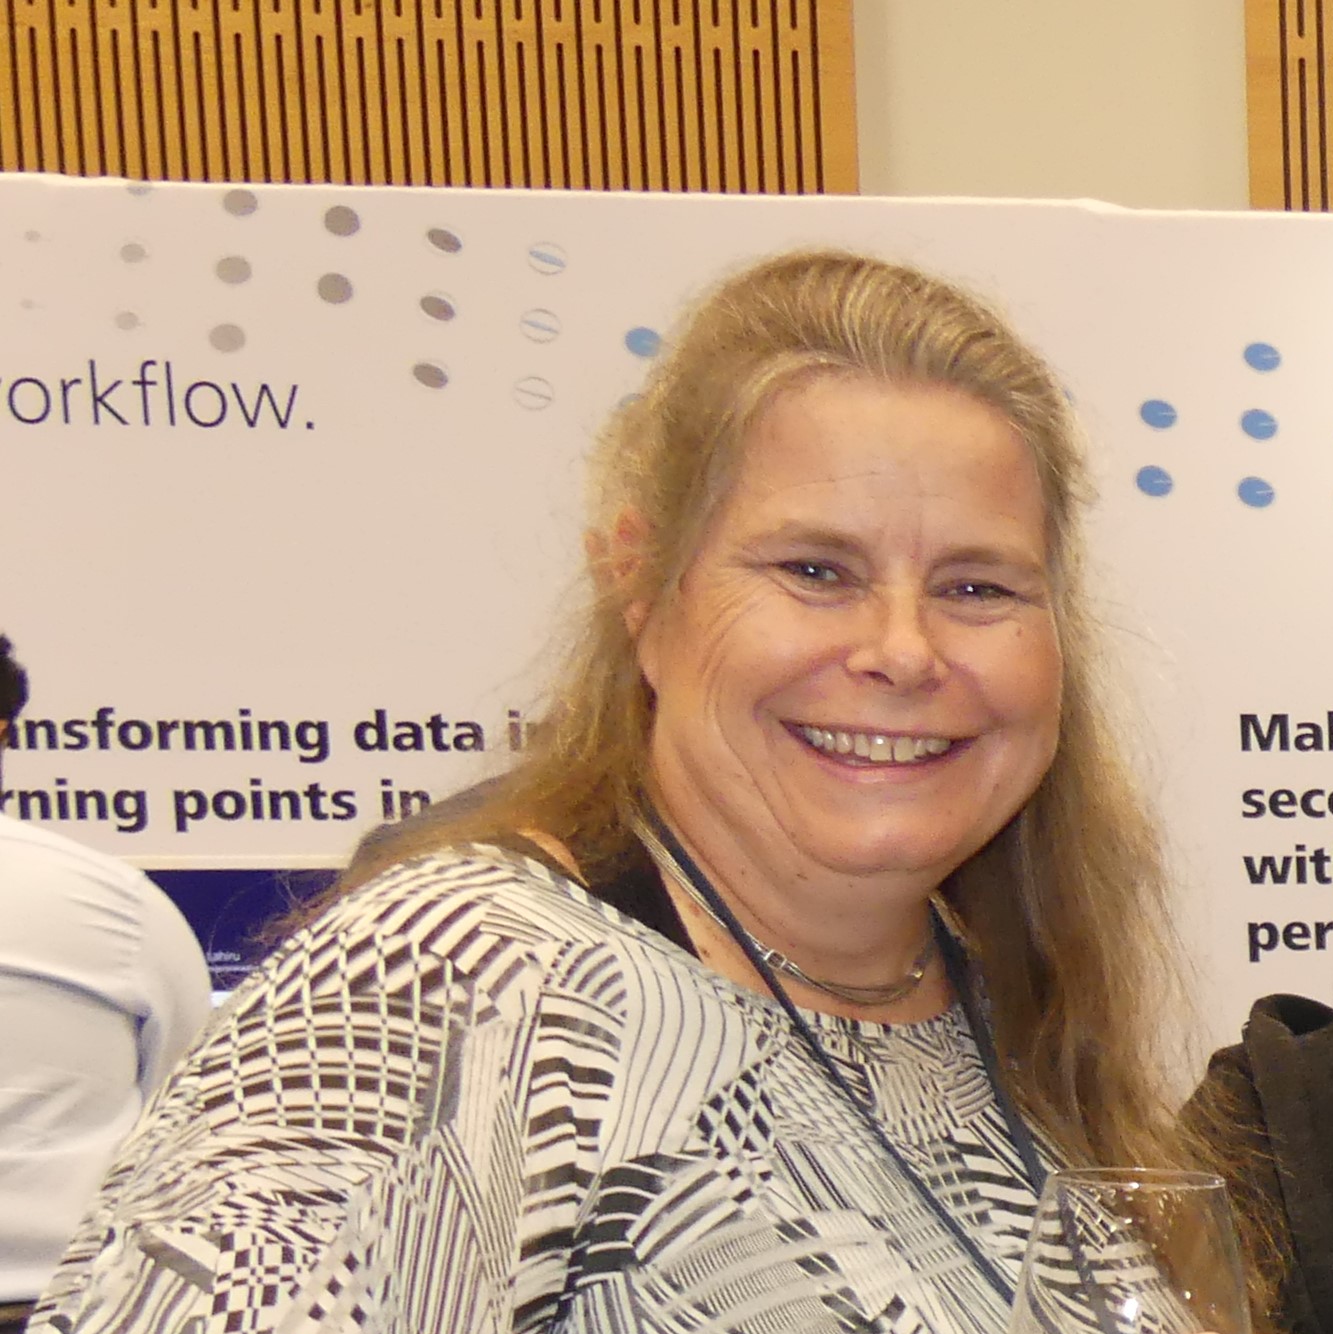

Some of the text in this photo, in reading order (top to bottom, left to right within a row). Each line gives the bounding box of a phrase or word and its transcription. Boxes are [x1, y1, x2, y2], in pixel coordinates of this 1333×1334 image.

[0, 359, 315, 430] orkflow.
[353, 708, 485, 753] data
[174, 778, 358, 833] points
